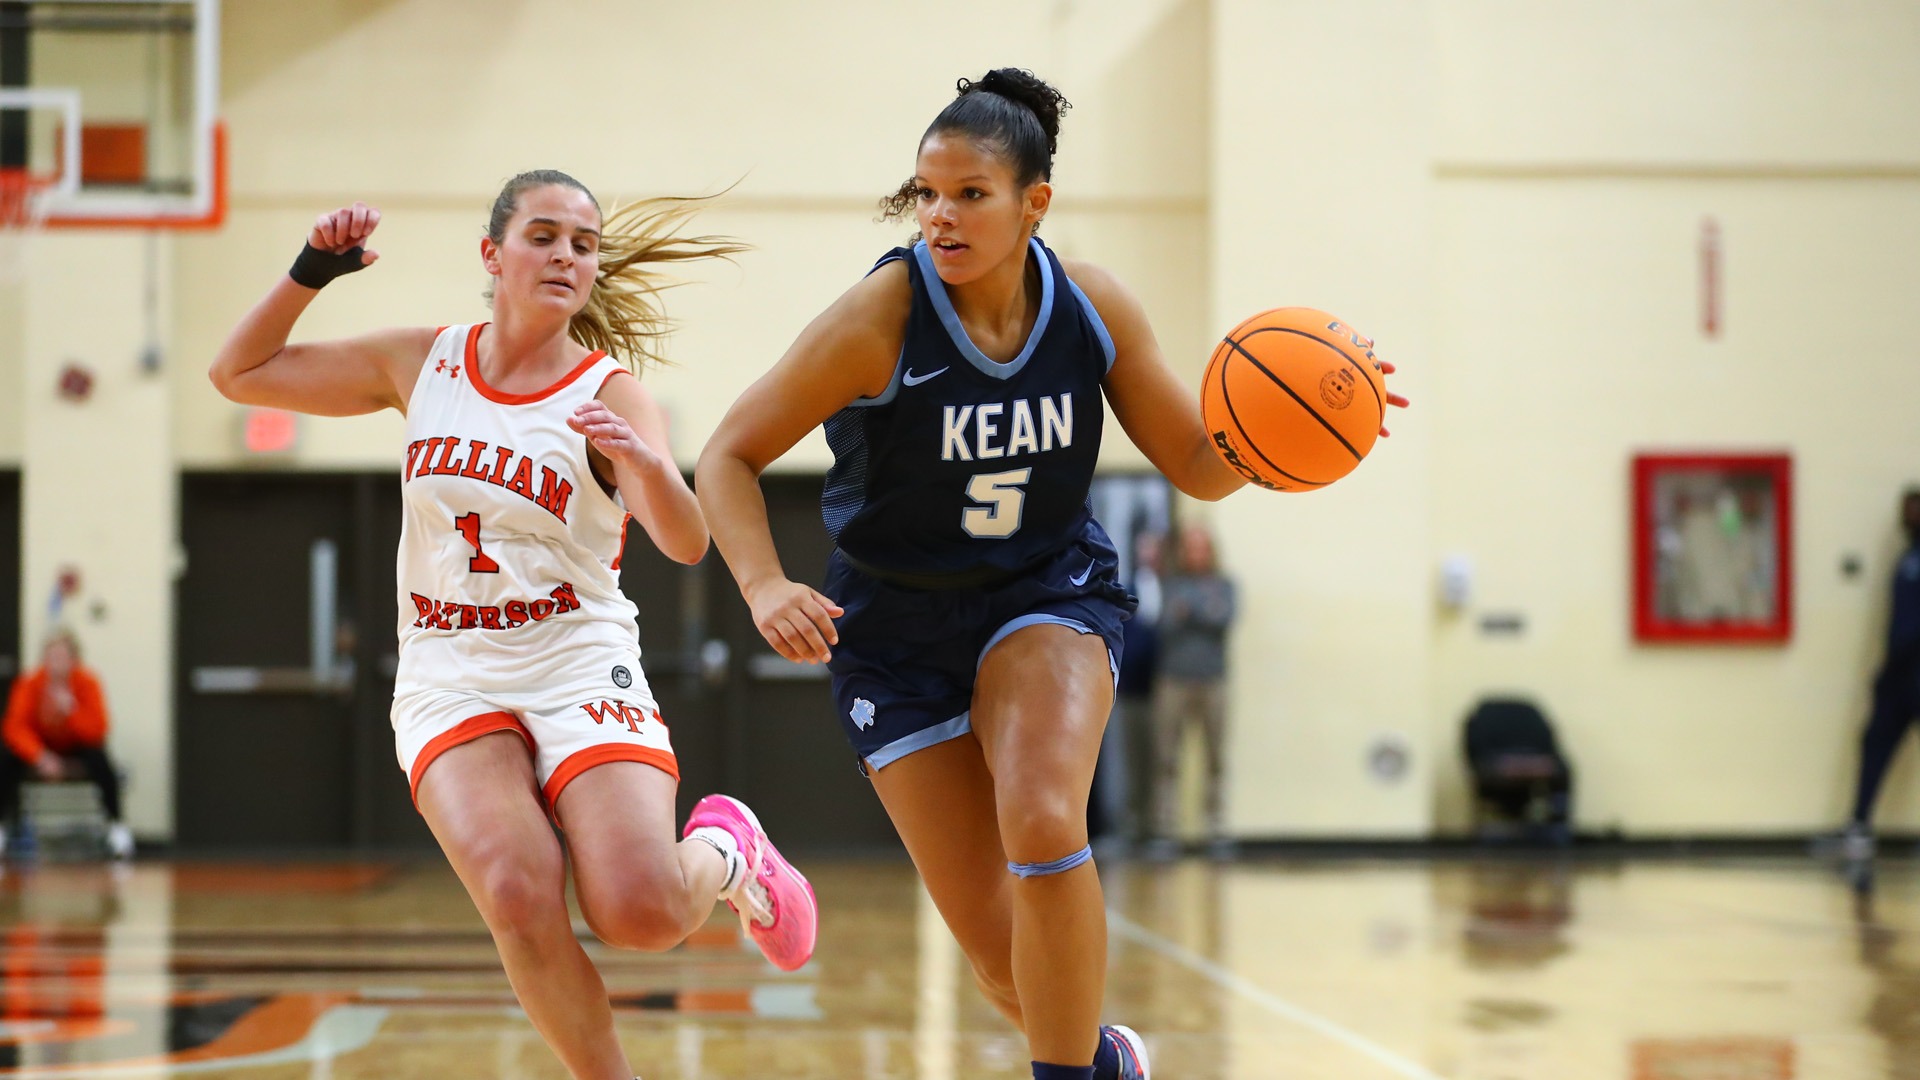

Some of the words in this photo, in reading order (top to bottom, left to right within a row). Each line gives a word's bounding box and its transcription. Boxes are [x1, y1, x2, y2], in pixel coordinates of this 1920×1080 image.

[940, 392, 1073, 462] KEAN
[1212, 430, 1288, 490] NCAA
[960, 466, 1033, 540] 5
[454, 511, 500, 574] 1
[410, 582, 582, 631] PATERSON
[579, 699, 646, 735] WP
